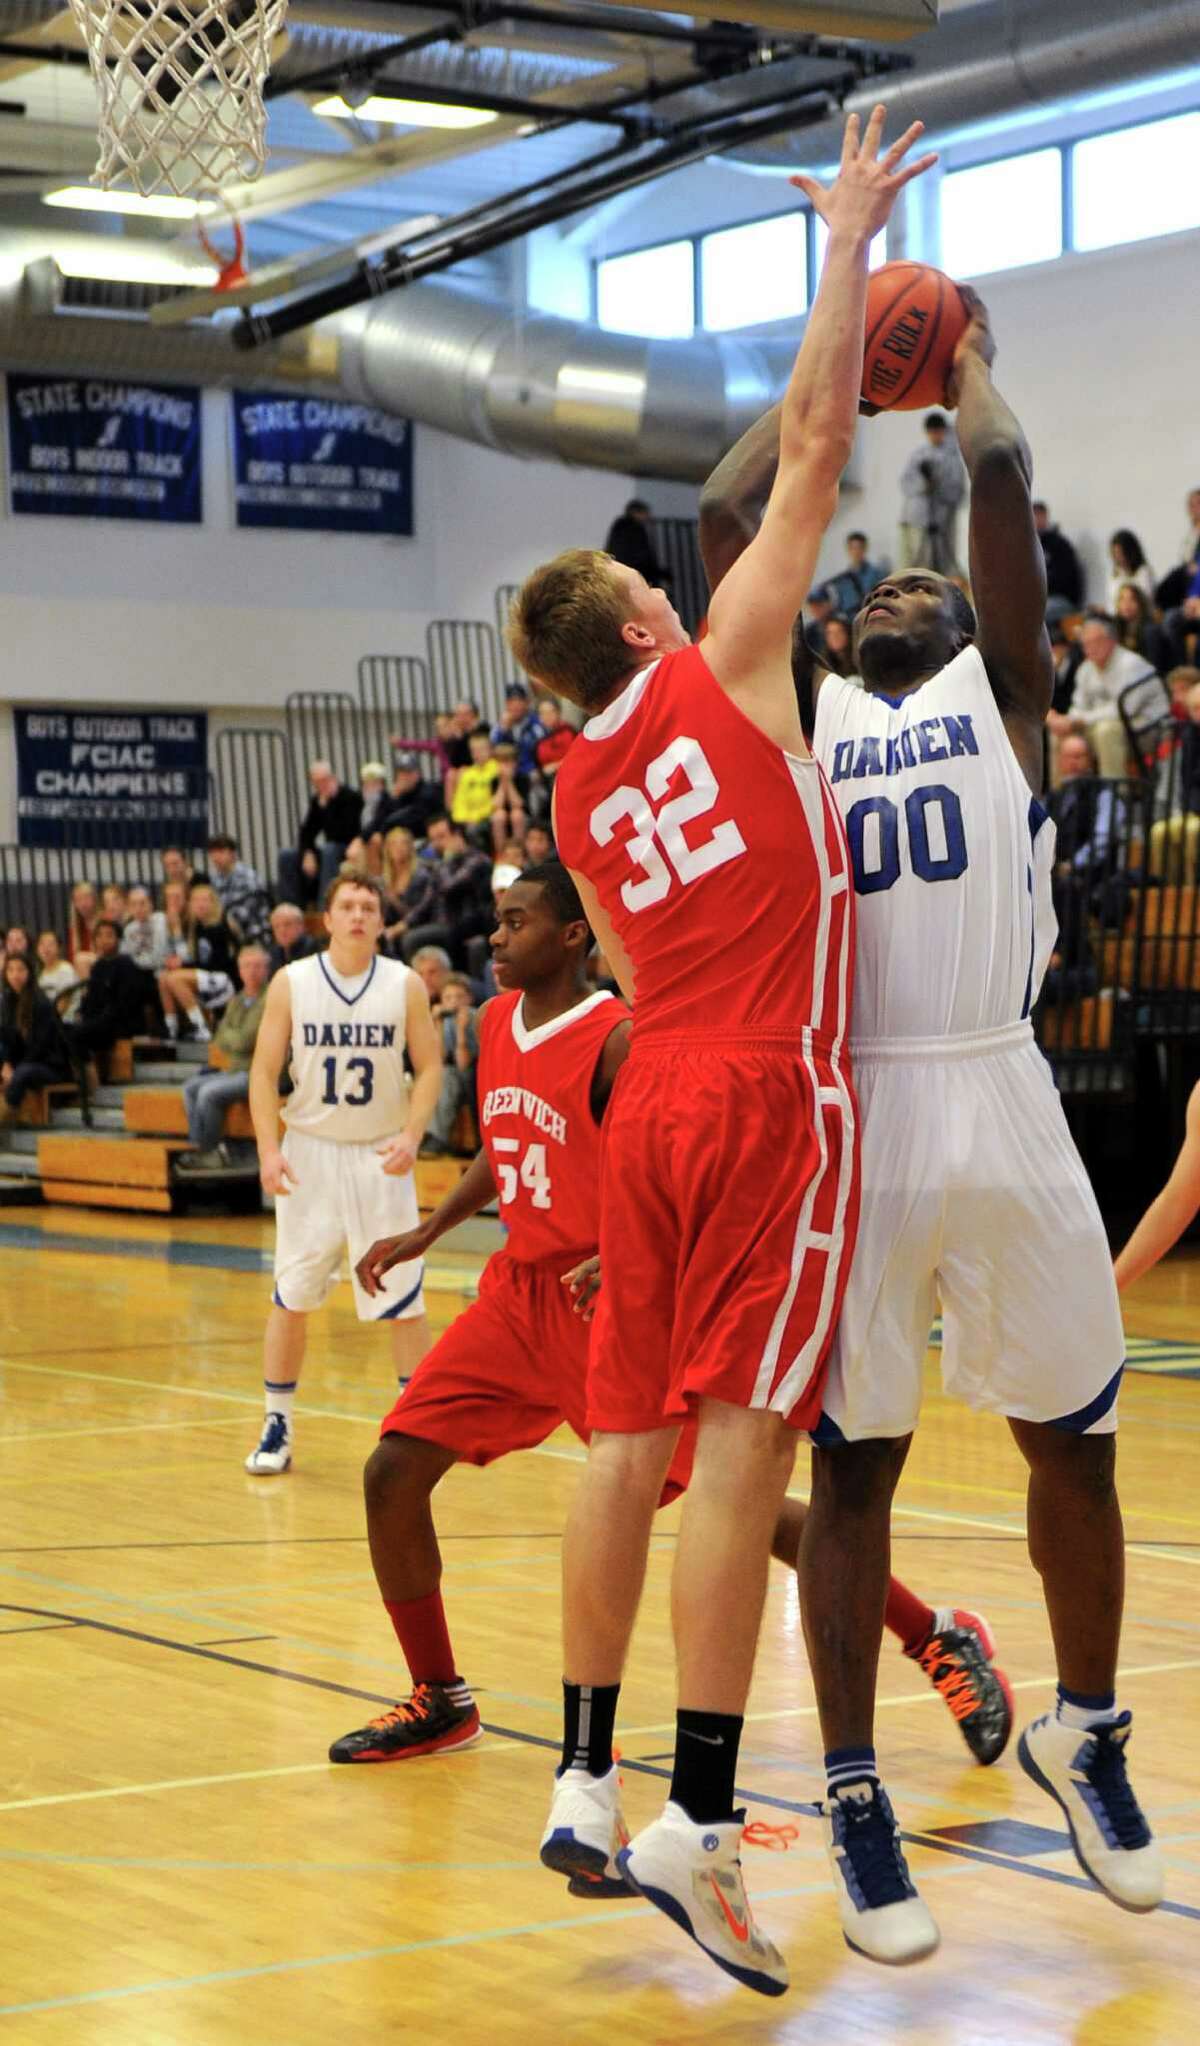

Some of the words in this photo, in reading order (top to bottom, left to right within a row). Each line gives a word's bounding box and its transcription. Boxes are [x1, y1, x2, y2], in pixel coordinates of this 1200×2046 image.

[883, 307, 928, 360] ROCK
[16, 384, 82, 419] STATE
[85, 383, 195, 430] CHAMPIONS
[241, 401, 301, 436] STATE
[303, 400, 406, 446] CHAMPIONS
[29, 445, 69, 470] BOYS
[135, 450, 183, 478] TRACK
[27, 715, 68, 740] BOYS
[73, 717, 143, 741] OUTDOOR
[149, 717, 196, 741] TRACK
[831, 714, 979, 783] DARIEN
[71, 744, 156, 768] FCIAC
[36, 770, 187, 796] CHAMPIONS
[590, 736, 747, 913] 32
[846, 784, 968, 895] 00
[303, 1024, 396, 1048] DARIEN
[322, 1056, 374, 1106] 13
[492, 1137, 551, 1209] 54
